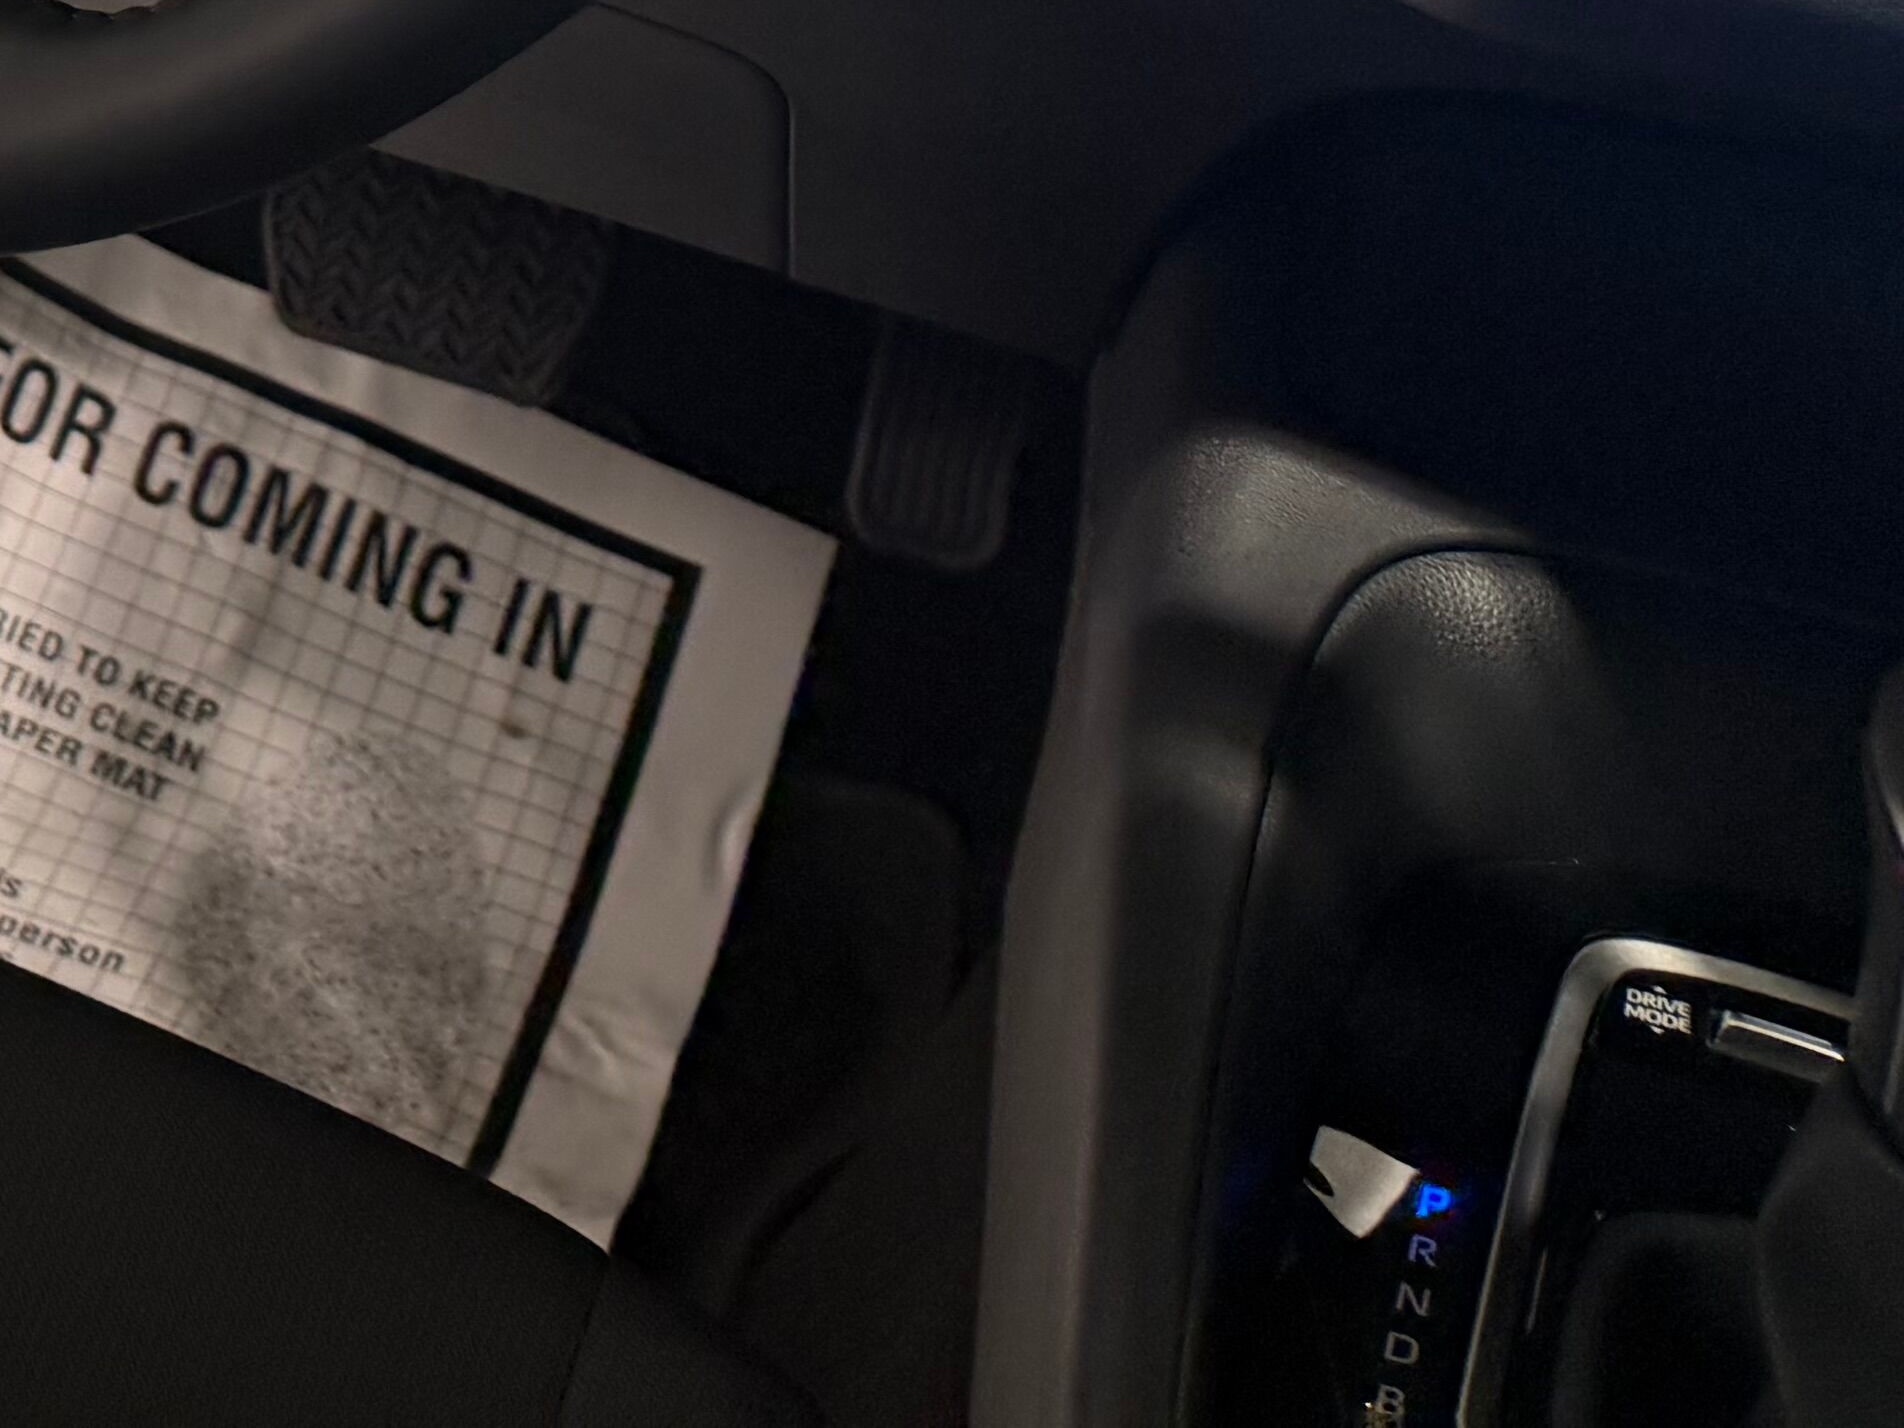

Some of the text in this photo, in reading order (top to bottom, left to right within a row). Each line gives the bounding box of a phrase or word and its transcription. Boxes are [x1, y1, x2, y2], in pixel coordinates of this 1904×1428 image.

[134, 420, 473, 634] COMING
[494, 577, 593, 684] IN
[76, 644, 122, 687] TO
[129, 670, 220, 726] KEEP
[90, 701, 207, 773] CLEAN
[90, 749, 174, 802] MAT
[1623, 1002, 1693, 1035] MODE
[1626, 987, 1691, 1017] DRIVE
[1416, 1183, 1452, 1217] P
[1408, 1234, 1437, 1267] R
[1395, 1280, 1432, 1317] N
[1384, 1331, 1420, 1365] D
